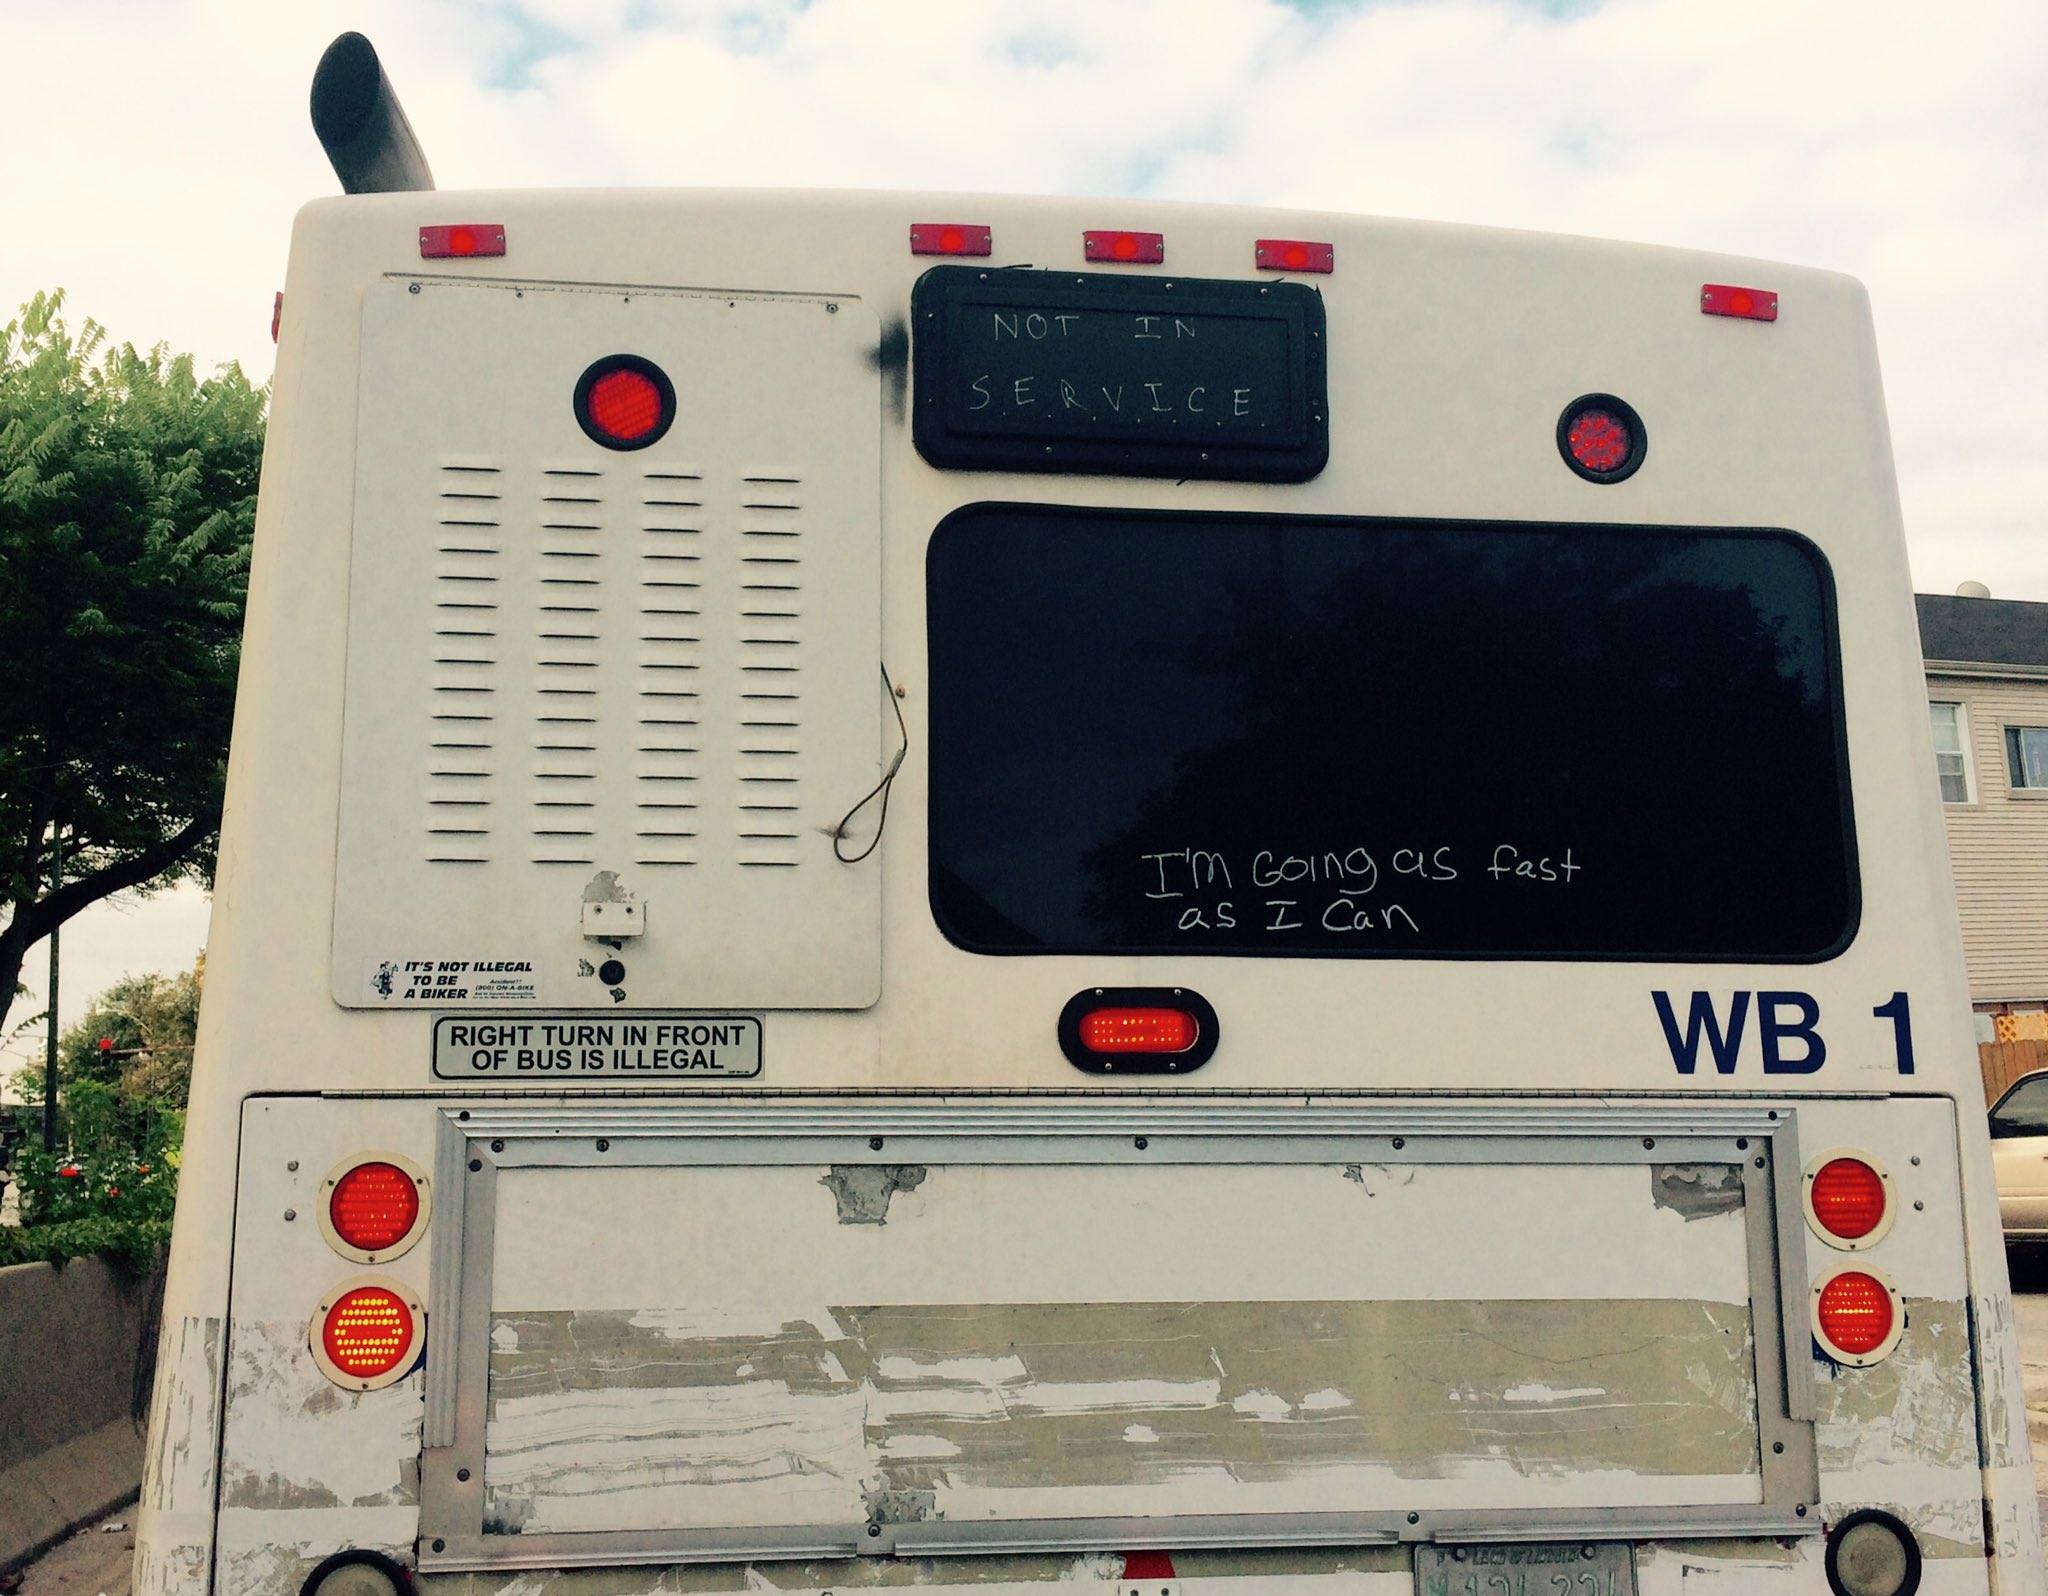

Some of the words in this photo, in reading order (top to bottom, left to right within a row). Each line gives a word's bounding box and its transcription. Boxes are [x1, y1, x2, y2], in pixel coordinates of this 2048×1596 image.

[994, 312, 1080, 341] NOT
[1134, 315, 1196, 339] IN
[969, 374, 1251, 416] SERVICE
[1253, 847, 1378, 895] Going
[1392, 846, 1458, 880] as
[1487, 844, 1581, 882] fast
[1178, 902, 1236, 930] as
[1265, 900, 1303, 930] I
[1322, 898, 1419, 932] Can
[404, 961, 434, 973] IT'S
[438, 961, 470, 973] NOT
[473, 961, 533, 973] ILLEGAL
[413, 975, 433, 986] TO
[436, 975, 459, 986] BE
[404, 988, 416, 1000] A
[420, 988, 469, 1000] BIKER
[450, 1025, 534, 1047] RIGHT
[540, 1025, 614, 1047] TURN
[622, 1025, 648, 1046] IN
[656, 1025, 746, 1047] FRONT
[1650, 990, 1827, 1075] WB
[1873, 991, 1915, 1075] 1
[471, 1049, 509, 1071] OF
[516, 1049, 573, 1071] BUS
[580, 1049, 605, 1071] IS
[612, 1049, 725, 1070] ILLEGAL
